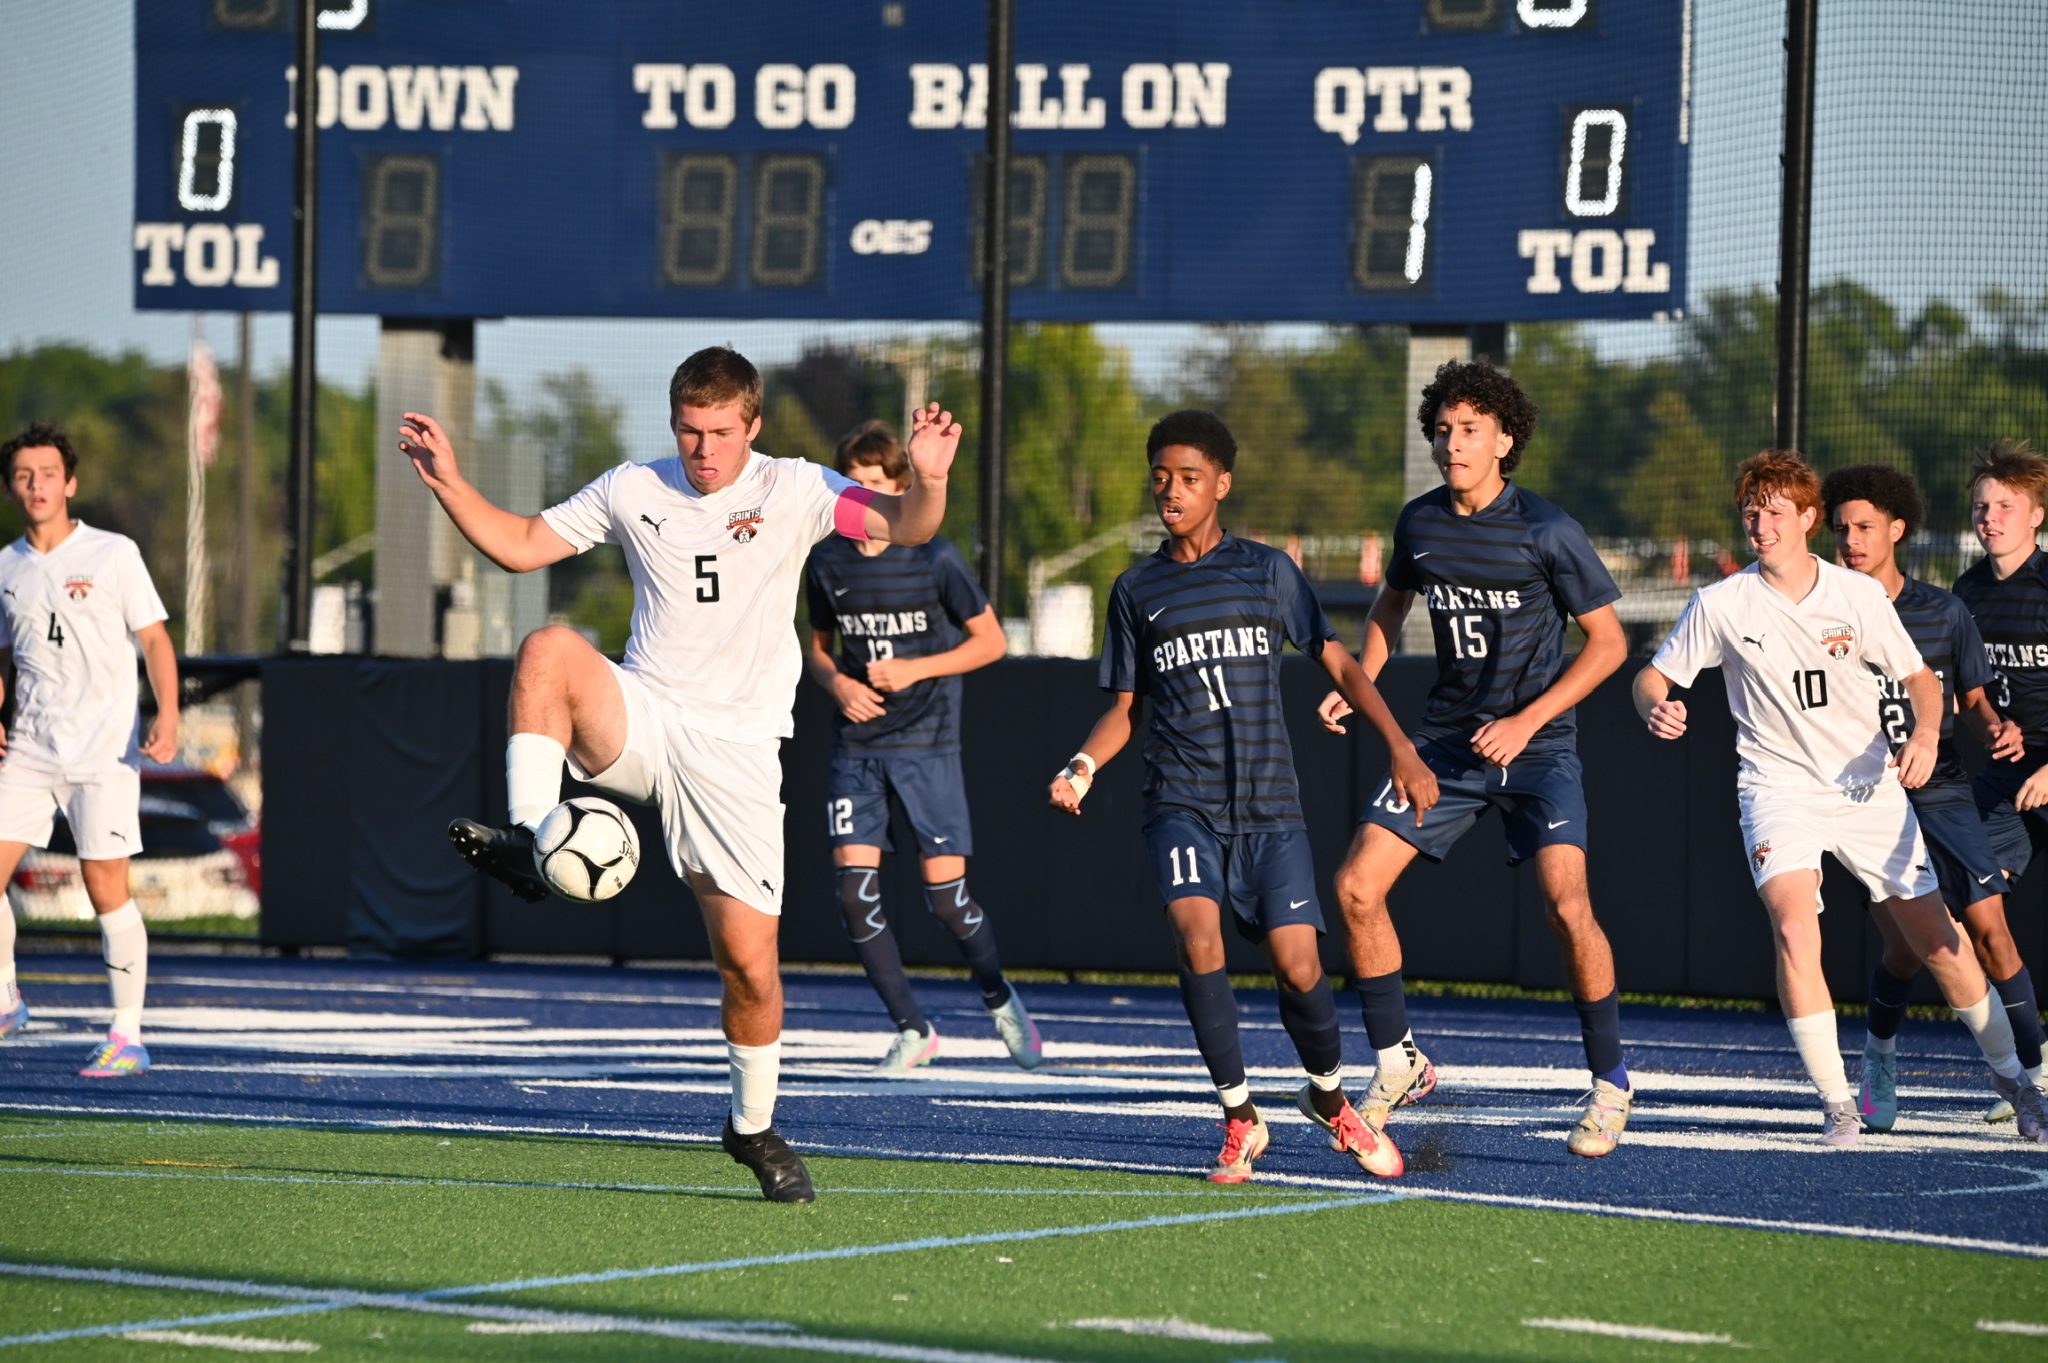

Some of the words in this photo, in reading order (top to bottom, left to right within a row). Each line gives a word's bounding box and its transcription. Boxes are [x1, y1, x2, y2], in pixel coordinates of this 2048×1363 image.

[633, 63, 735, 129] TO
[755, 63, 856, 129] GO
[1122, 63, 1230, 127] ON
[1314, 66, 1474, 145] QTR
[178, 108, 237, 211] 0
[1565, 109, 1627, 216] 0
[1404, 162, 1432, 284] 1
[135, 223, 279, 287] TOL
[1518, 229, 1670, 294] TOL
[729, 506, 761, 524] SAINTS
[695, 554, 720, 603] 5
[47, 611, 65, 649] 4
[1153, 626, 1270, 673] SPARTANS
[1449, 615, 1488, 659] 15
[1198, 664, 1232, 712] 11
[1792, 669, 1828, 711] 10
[827, 797, 854, 837] 12
[1169, 846, 1202, 887] 11
